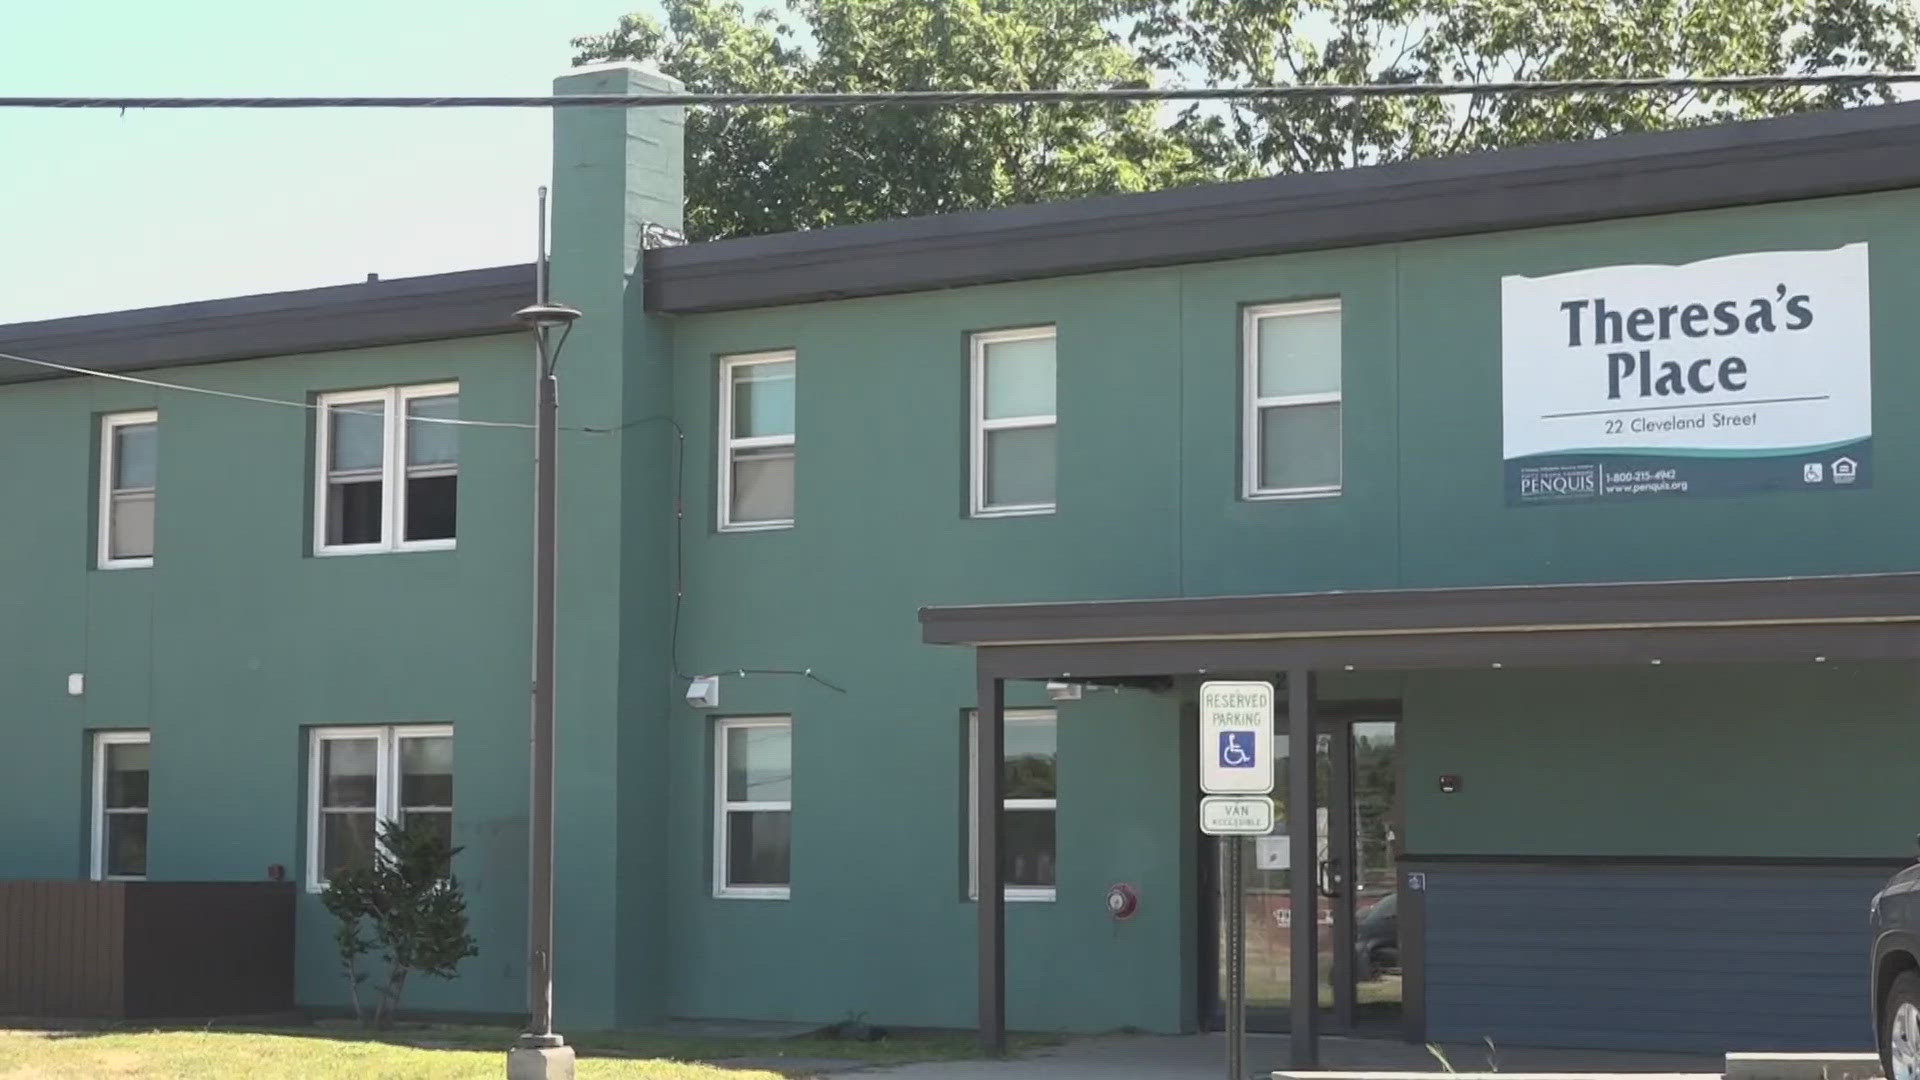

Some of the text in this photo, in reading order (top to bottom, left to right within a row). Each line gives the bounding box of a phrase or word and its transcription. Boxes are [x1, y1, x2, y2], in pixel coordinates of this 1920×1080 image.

[1560, 283, 1814, 348] Theresa's
[1607, 349, 1747, 400] Place
[1604, 412, 1757, 434] 22 Cleveland Street
[1521, 475, 1594, 494] PENQUIS
[1606, 481, 1688, 494] www.penquis.org
[1206, 693, 1267, 708] RESERVED
[1212, 712, 1261, 726] PARKING
[1225, 805, 1249, 816] VAN
